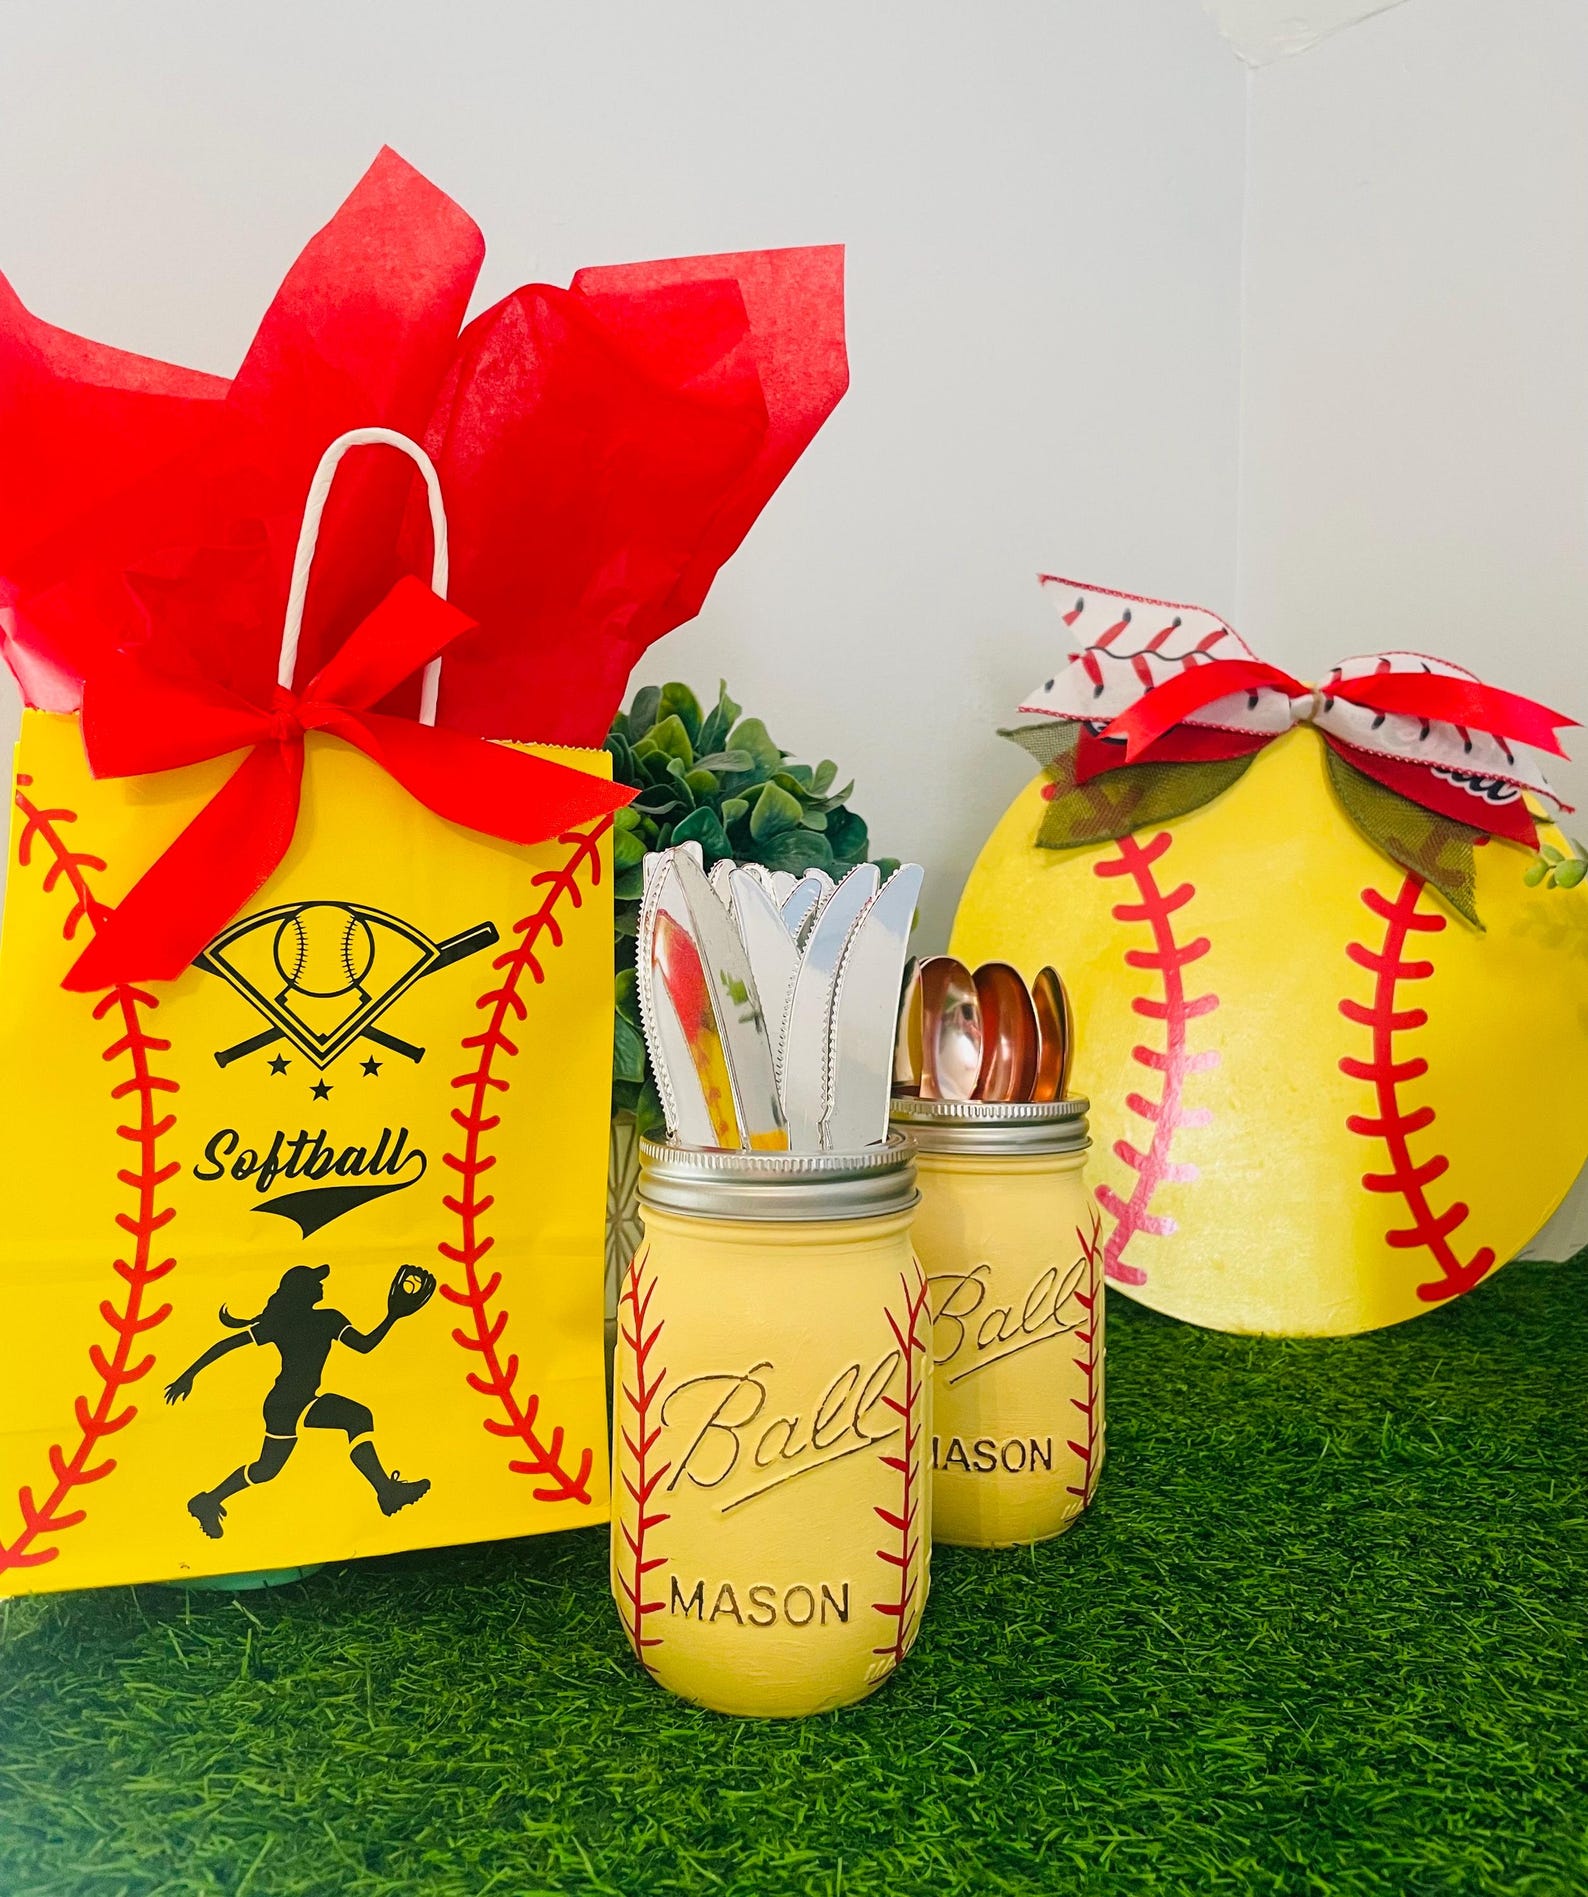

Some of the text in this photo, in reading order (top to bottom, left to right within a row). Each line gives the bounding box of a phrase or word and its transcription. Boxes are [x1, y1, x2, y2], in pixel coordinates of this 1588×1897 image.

[193, 1127, 427, 1193] Softball
[927, 1257, 1088, 1366] Ball
[660, 1349, 900, 1491] Ball
[670, 1575, 849, 1626] MASON
